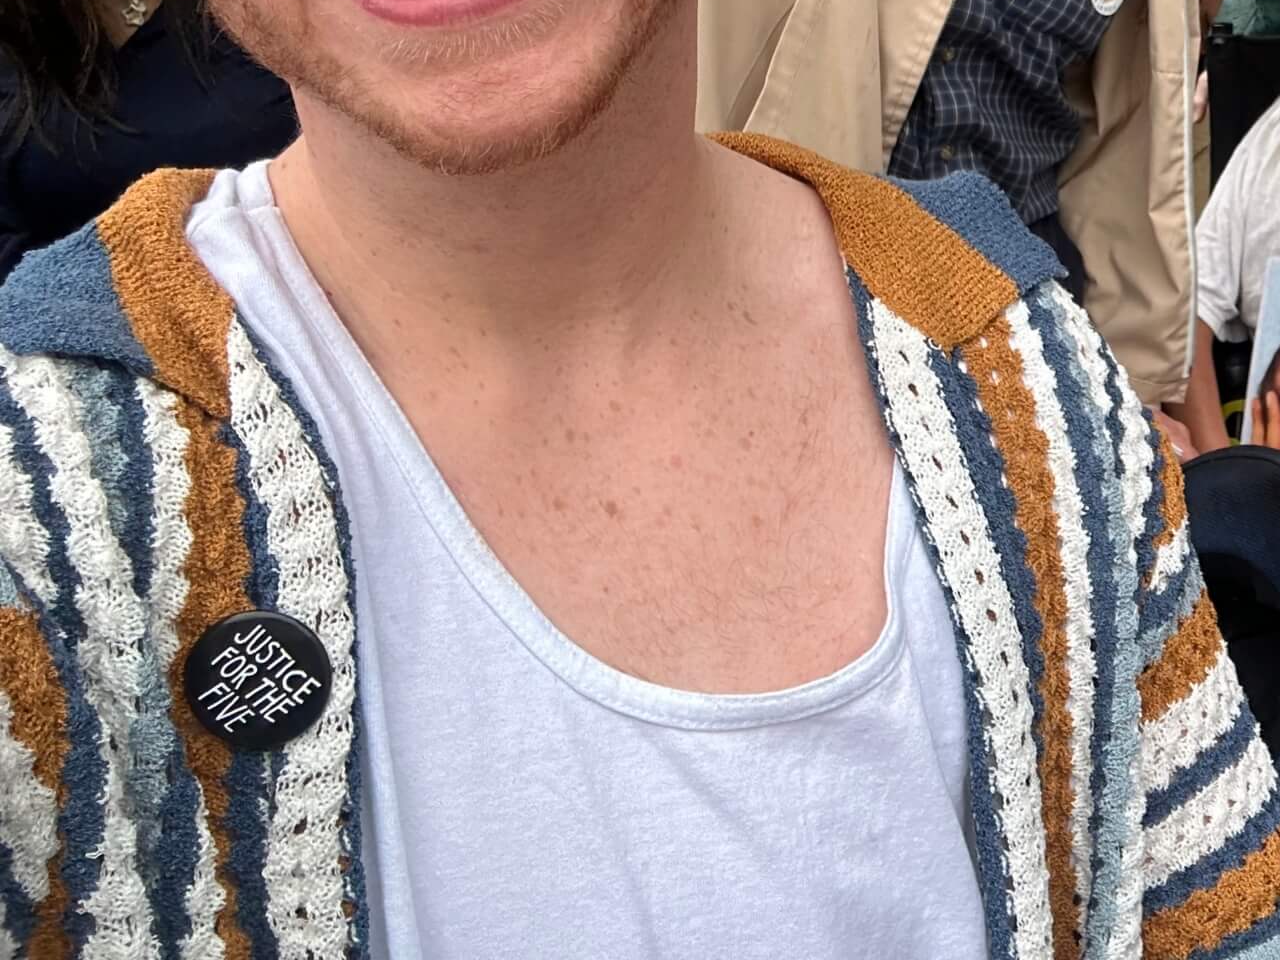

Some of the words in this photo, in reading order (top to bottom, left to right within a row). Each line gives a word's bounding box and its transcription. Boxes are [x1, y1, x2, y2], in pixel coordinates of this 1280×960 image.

[211, 646, 258, 690] FOR
[244, 677, 297, 724] THE
[234, 624, 322, 705] JUSTICE
[198, 682, 256, 733] FIVE
